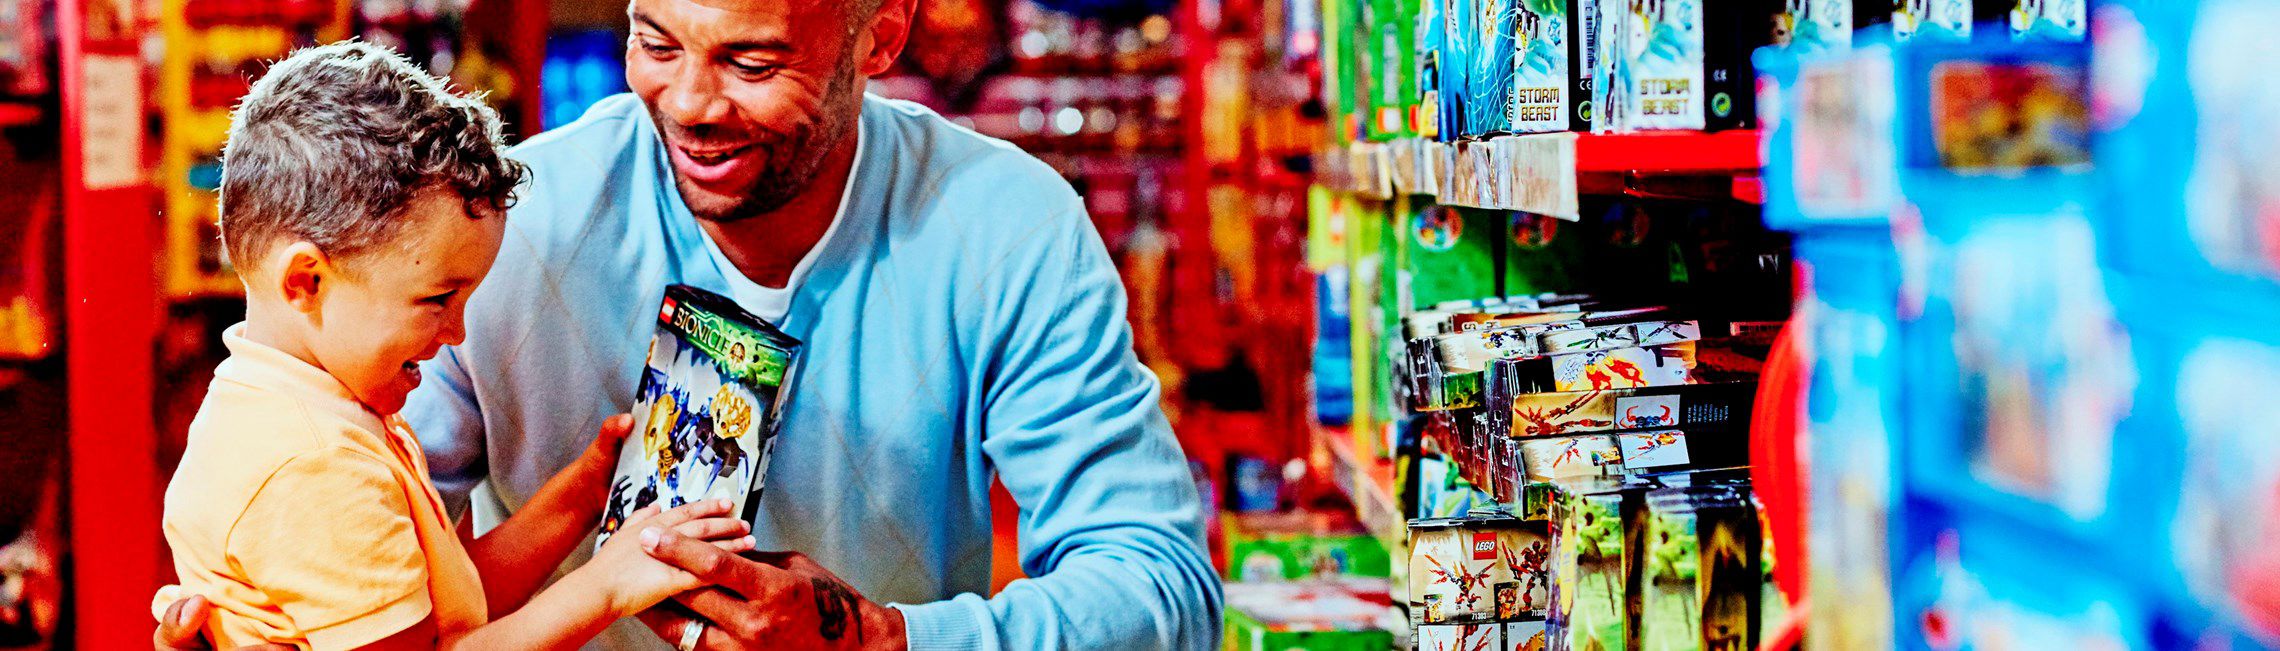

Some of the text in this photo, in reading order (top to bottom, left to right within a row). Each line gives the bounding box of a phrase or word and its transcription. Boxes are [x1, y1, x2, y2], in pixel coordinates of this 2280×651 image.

[1640, 79, 1690, 95] STORM
[1518, 88, 1560, 104] STORM
[1521, 106, 1559, 121] BEAST
[1642, 99, 1688, 115] BEAST
[673, 307, 731, 353] BIONICLE
[1475, 541, 1495, 551] LEGO
